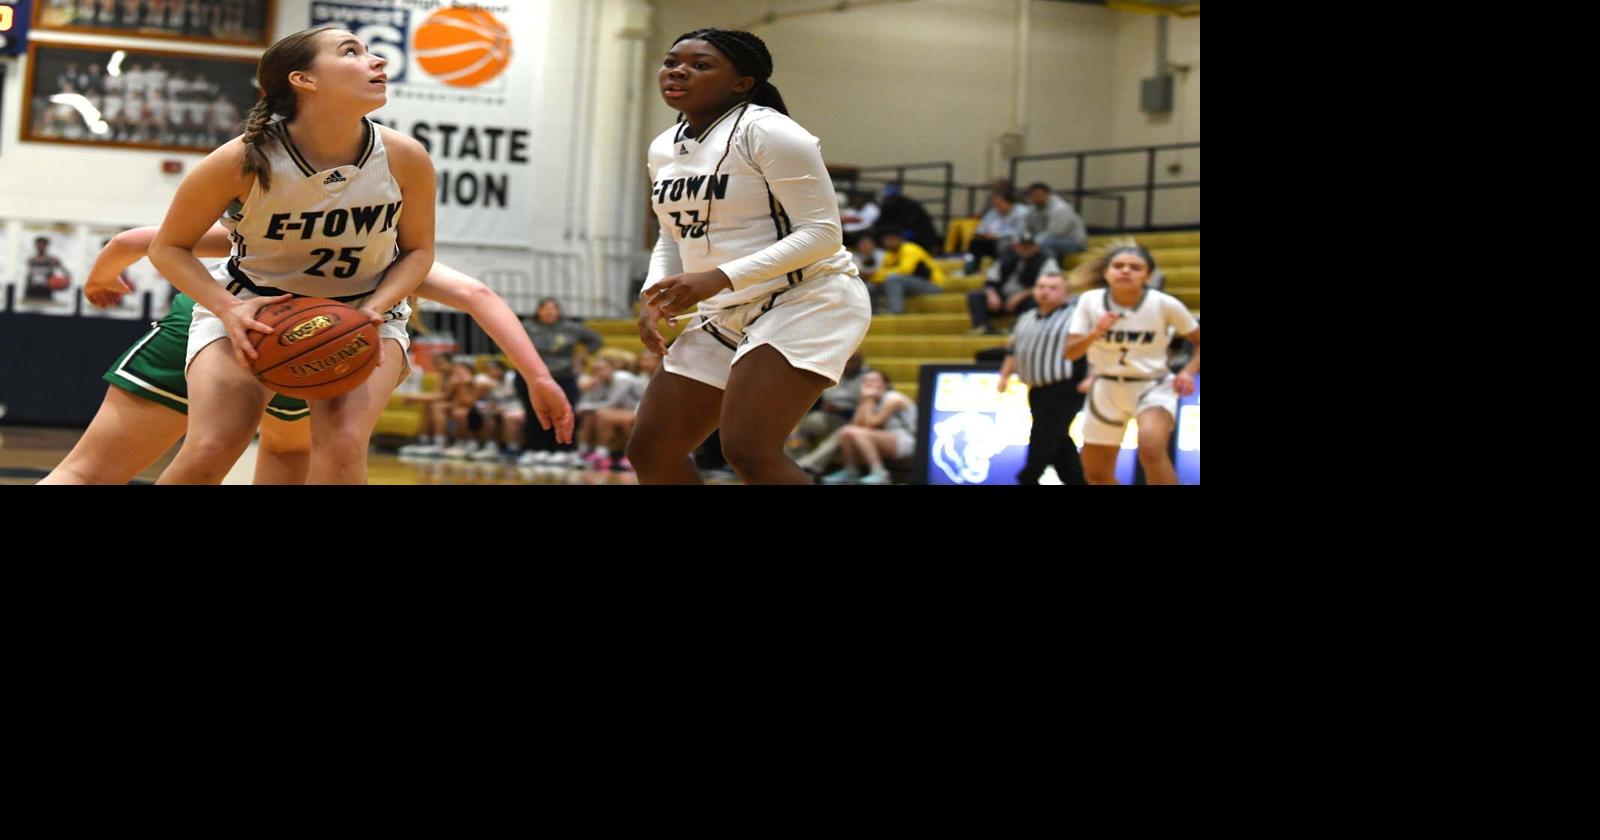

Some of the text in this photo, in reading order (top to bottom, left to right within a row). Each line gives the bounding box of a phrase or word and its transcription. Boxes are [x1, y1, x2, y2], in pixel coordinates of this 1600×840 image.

[412, 121, 530, 165] STATE
[437, 170, 508, 209] ION
[263, 200, 402, 241] E-TOWN
[303, 246, 366, 279] 25
